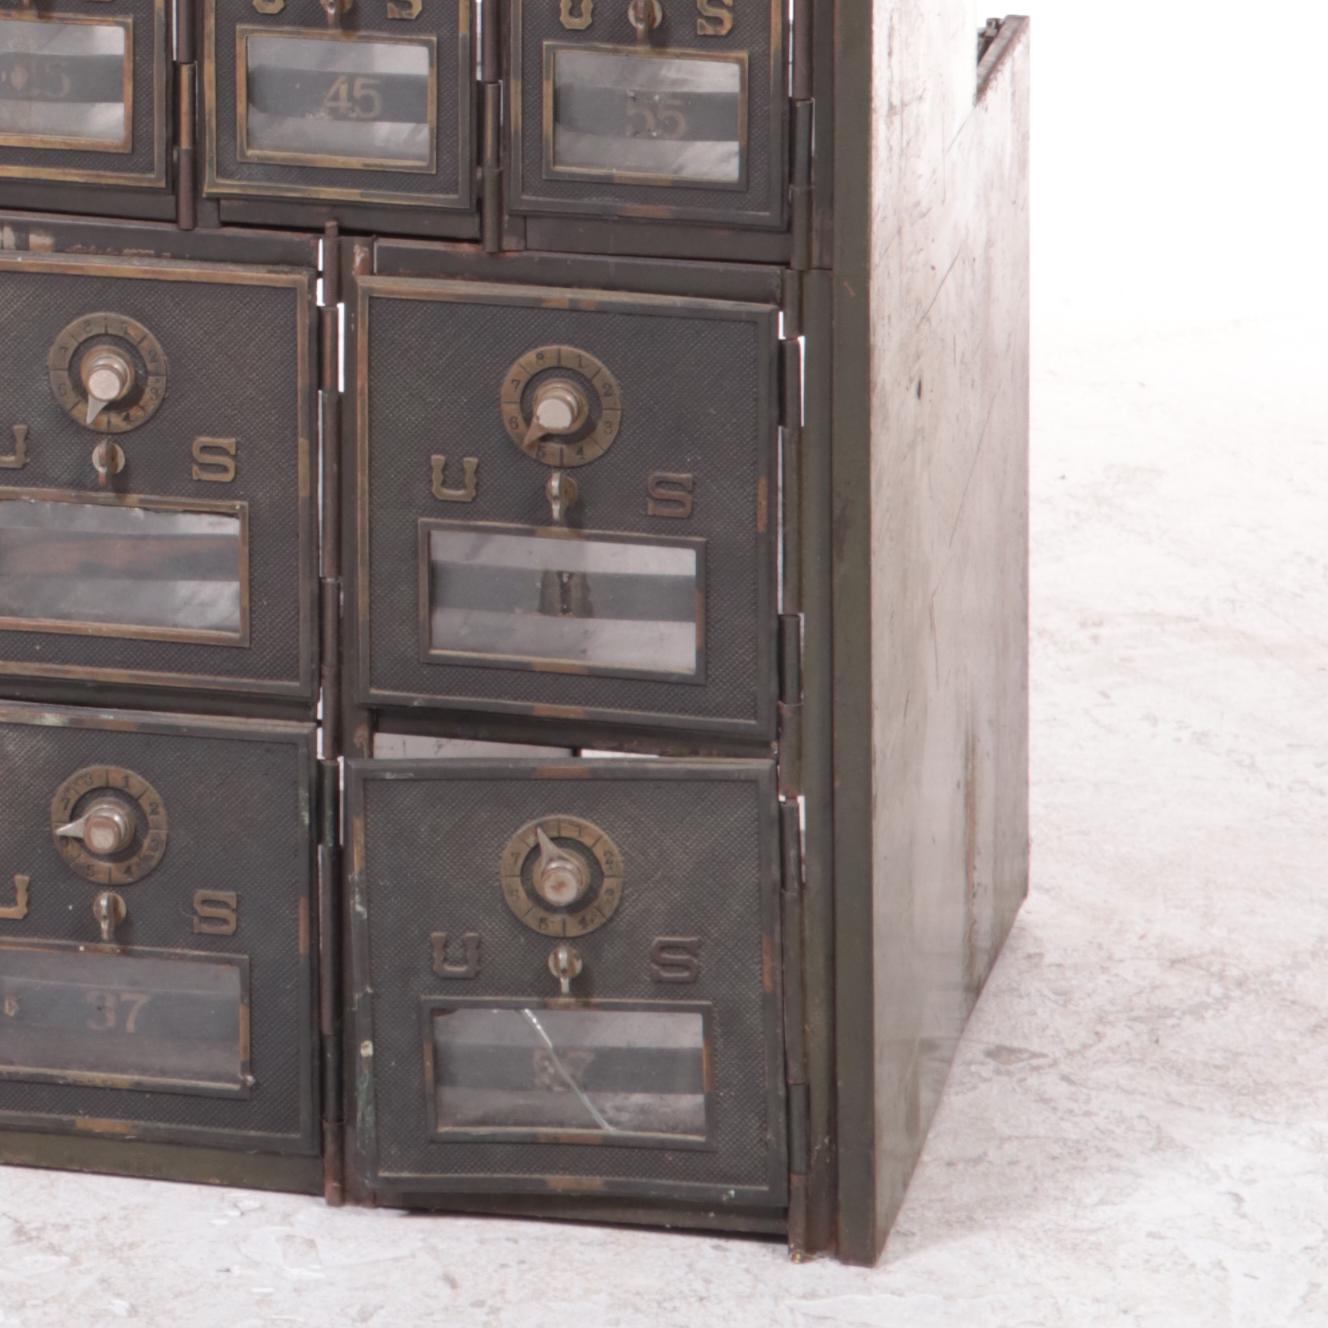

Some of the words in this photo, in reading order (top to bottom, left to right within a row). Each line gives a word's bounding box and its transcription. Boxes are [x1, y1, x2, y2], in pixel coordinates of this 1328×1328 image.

[324, 76, 383, 118] 45
[192, 436, 237, 483] S
[431, 454, 478, 502] U
[647, 471, 694, 518] S
[192, 889, 237, 935] S
[431, 931, 481, 978] U
[650, 935, 702, 983] S
[86, 991, 151, 1034] 37
